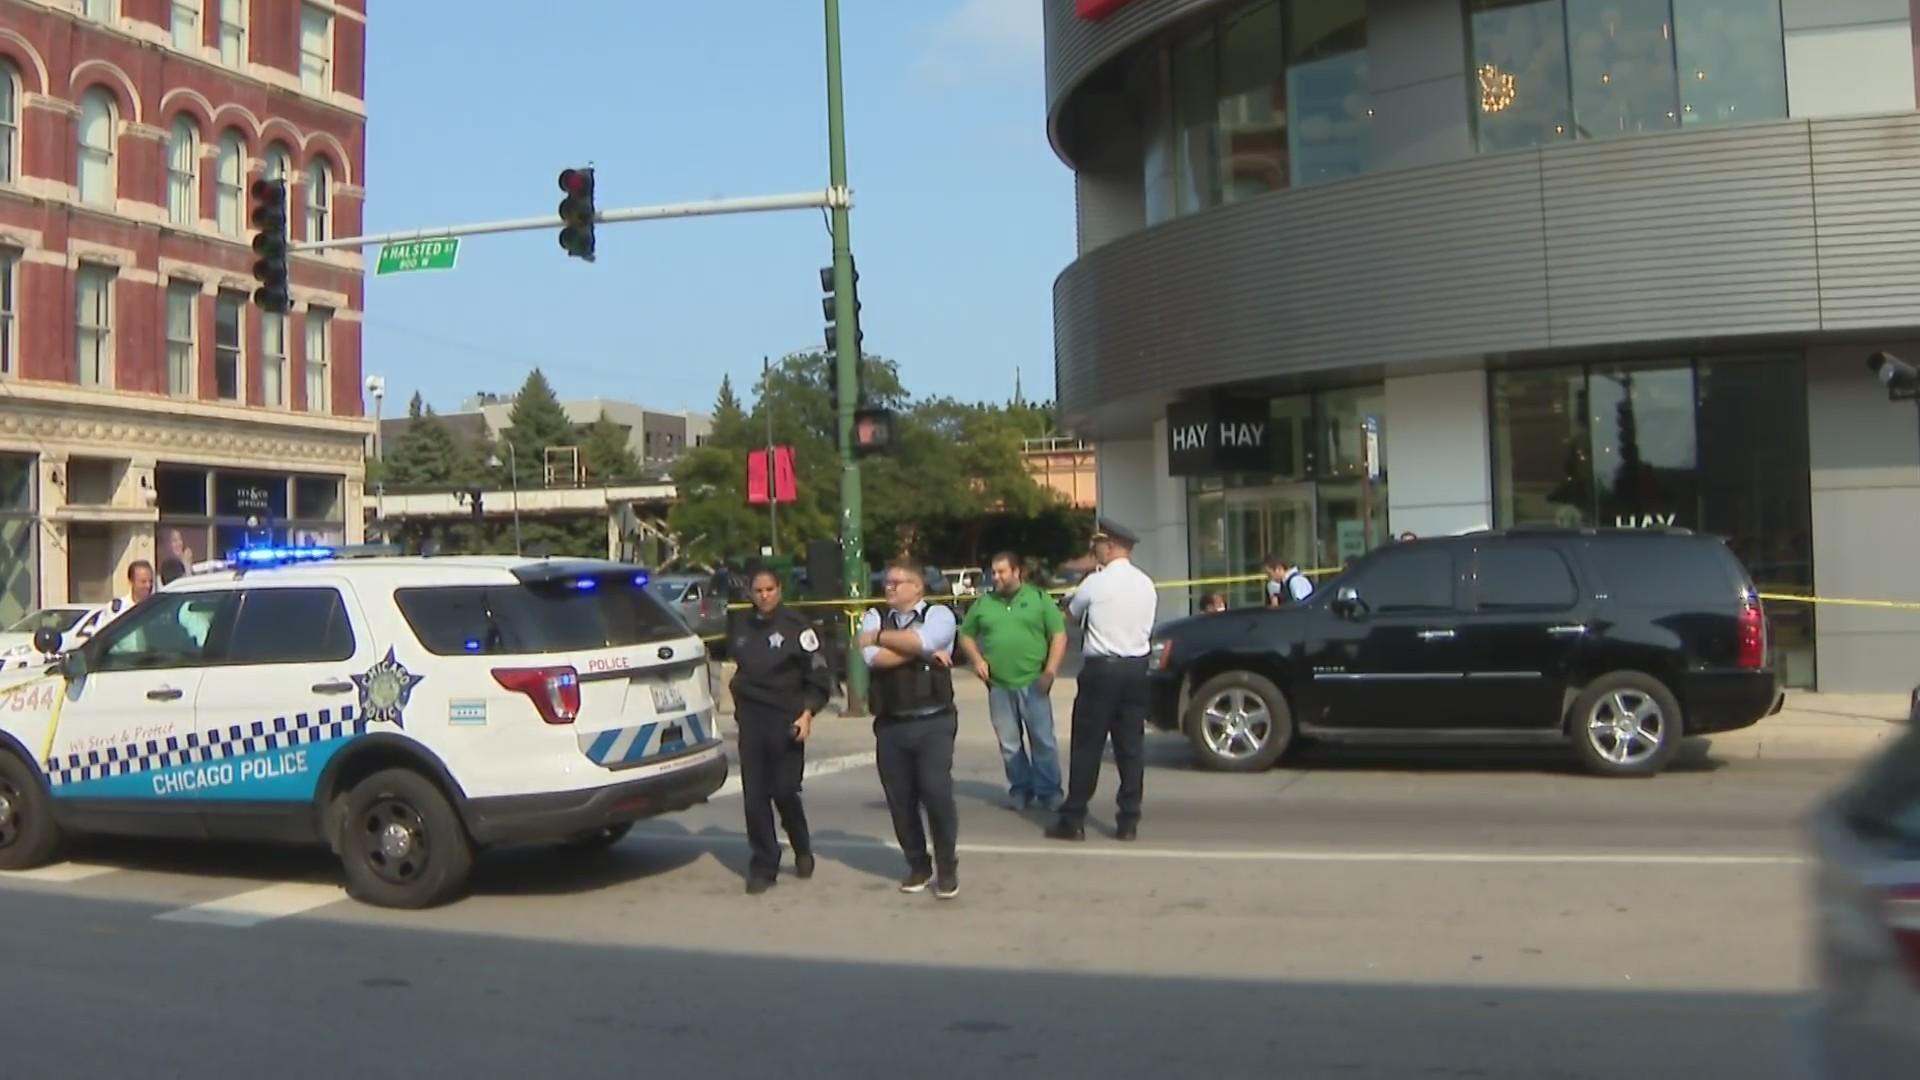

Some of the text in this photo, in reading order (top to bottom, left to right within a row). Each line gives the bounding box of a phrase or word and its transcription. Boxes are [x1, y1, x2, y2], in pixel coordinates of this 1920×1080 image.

[389, 242, 442, 260] HALSTED
[1173, 423, 1208, 451] HAY
[1220, 422, 1265, 447] HAY
[362, 661, 410, 686] CHICAGO
[588, 657, 631, 671] POLICE
[135, 722, 174, 740] Protect
[152, 750, 309, 795] CHICAGO POLICE
